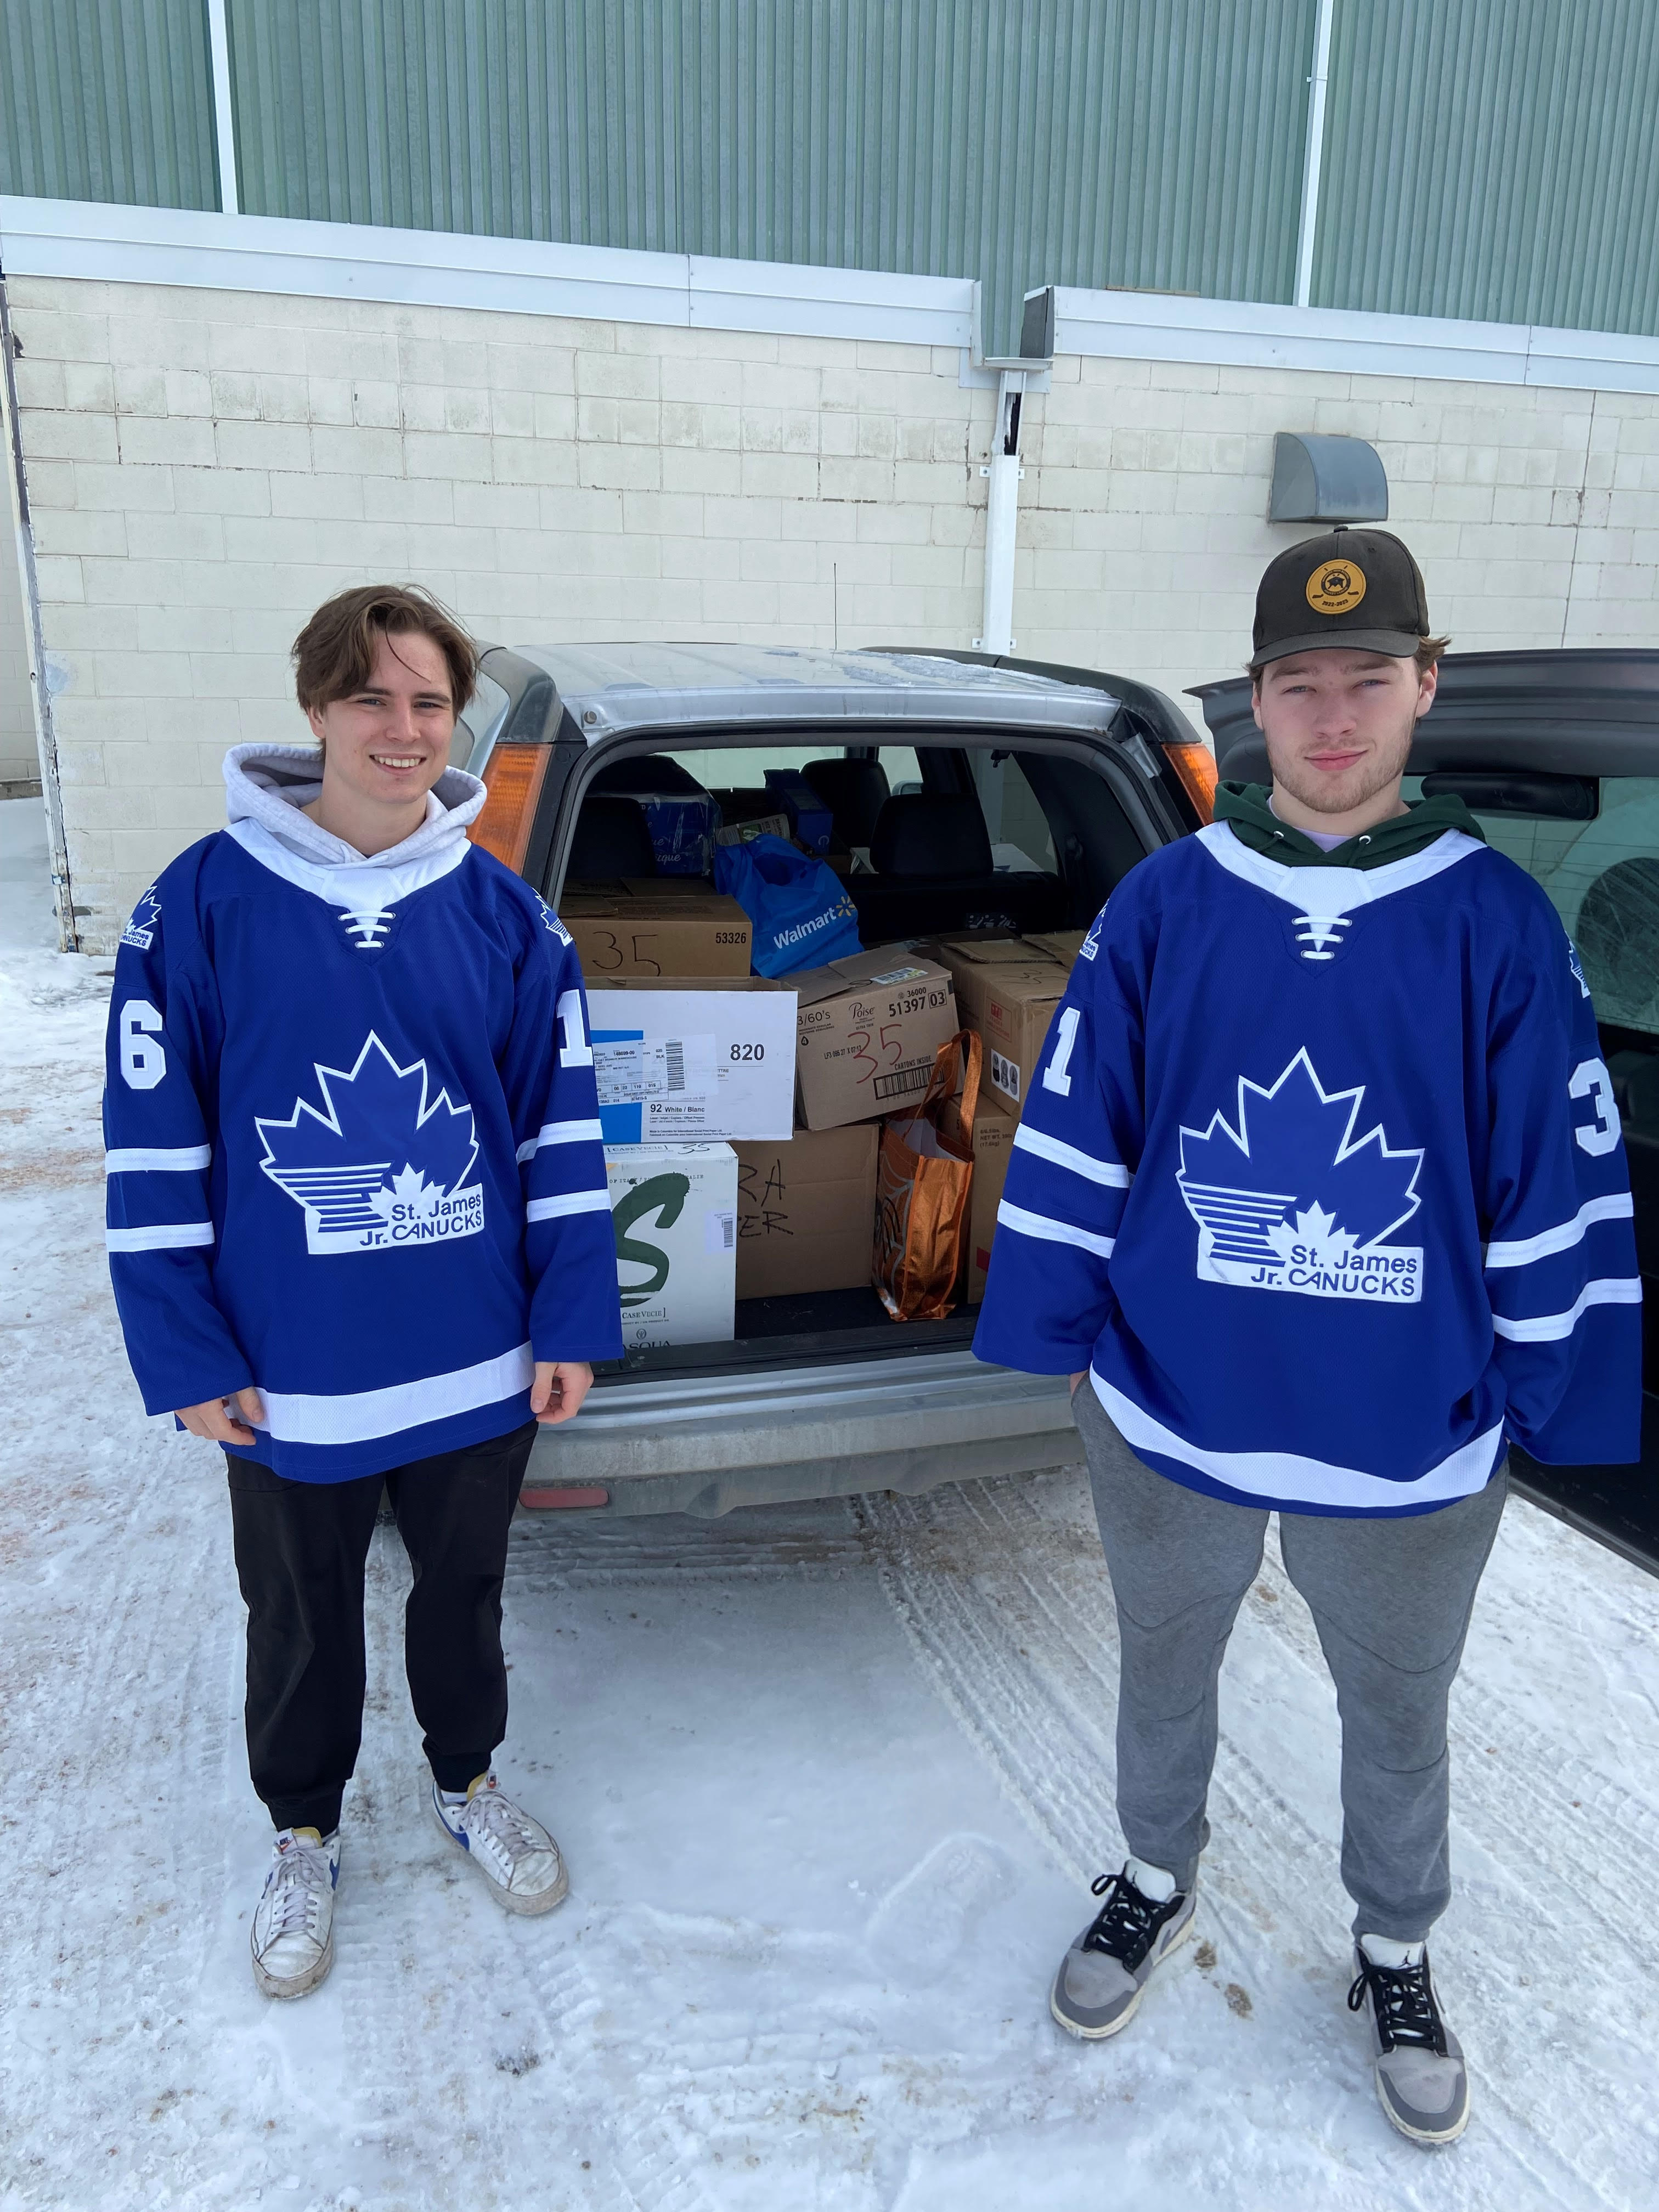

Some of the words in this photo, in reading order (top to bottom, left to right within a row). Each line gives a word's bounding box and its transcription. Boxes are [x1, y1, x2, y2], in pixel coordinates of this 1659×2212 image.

[128, 929, 149, 940] James
[715, 933, 747, 944] 53326
[774, 907, 837, 950] Walmart
[592, 931, 661, 977] 35
[889, 996, 926, 1017] 51397
[907, 986, 927, 998] 36000
[929, 992, 945, 1007] 03
[797, 1010, 831, 1026] 3/60's
[848, 1002, 875, 1019] Poise
[556, 989, 594, 1068] 1
[120, 1000, 167, 1090] 6
[730, 1043, 765, 1061] 820
[848, 1023, 902, 1084] 35
[1042, 1007, 1081, 1097] 1
[894, 1057, 916, 1071] CARTONS
[916, 1054, 932, 1066] INSIDE
[650, 1104, 662, 1113] 92
[1568, 1057, 1622, 1158] 3
[738, 1159, 786, 1207] RA
[391, 1203, 421, 1221] St.
[428, 1193, 481, 1218] James
[359, 1230, 388, 1246] Jr.
[392, 1210, 482, 1241] CANUCKS
[1290, 1244, 1324, 1268] St.
[1334, 1250, 1417, 1274] James
[1251, 1267, 1283, 1285] Jr.
[1288, 1268, 1415, 1297] CANUCKS
